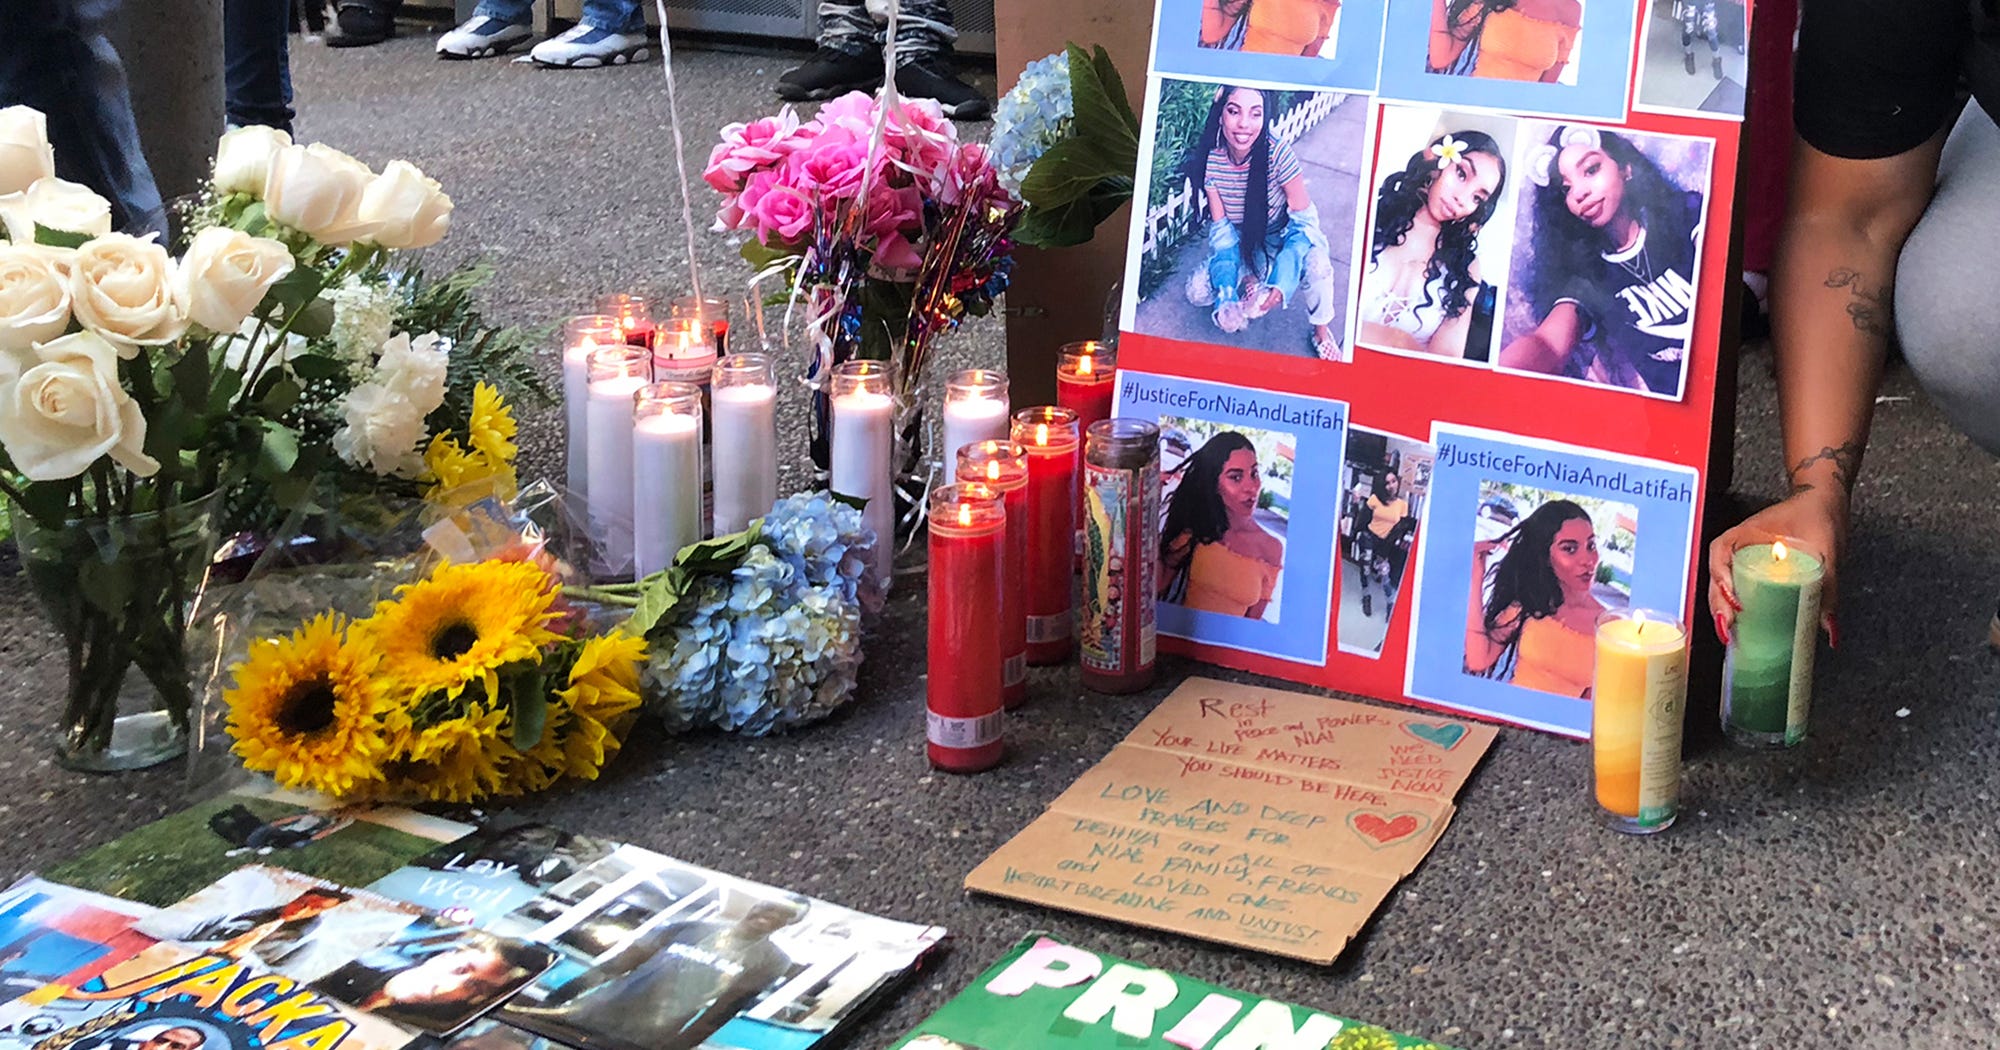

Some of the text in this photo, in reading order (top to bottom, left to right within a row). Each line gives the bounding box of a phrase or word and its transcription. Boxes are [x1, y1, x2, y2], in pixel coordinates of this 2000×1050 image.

[1123, 381, 1344, 431] #JusticeForNiaAndLatifah
[1438, 442, 1693, 504] #JusticeForNiaAndLatifah
[1200, 698, 1275, 719] Rest
[1207, 741, 1246, 756] LIFE
[1390, 755, 1442, 766] NEED
[1219, 766, 1293, 785] SHOULD
[1301, 779, 1328, 794] BE
[1377, 767, 1453, 780] JUSTICE
[1100, 782, 1327, 829] LOVE AND DEEP
[1139, 807, 1291, 846] PRAYERS FOR
[1177, 841, 1220, 856] and
[1227, 852, 1278, 868] ALL
[1291, 864, 1331, 877] OF
[1056, 859, 1101, 874] and
[1132, 872, 1210, 897] LOVED
[1256, 874, 1363, 904] FRIENDS
[1186, 907, 1232, 922] AND
[60, 954, 357, 1050] JACKA
